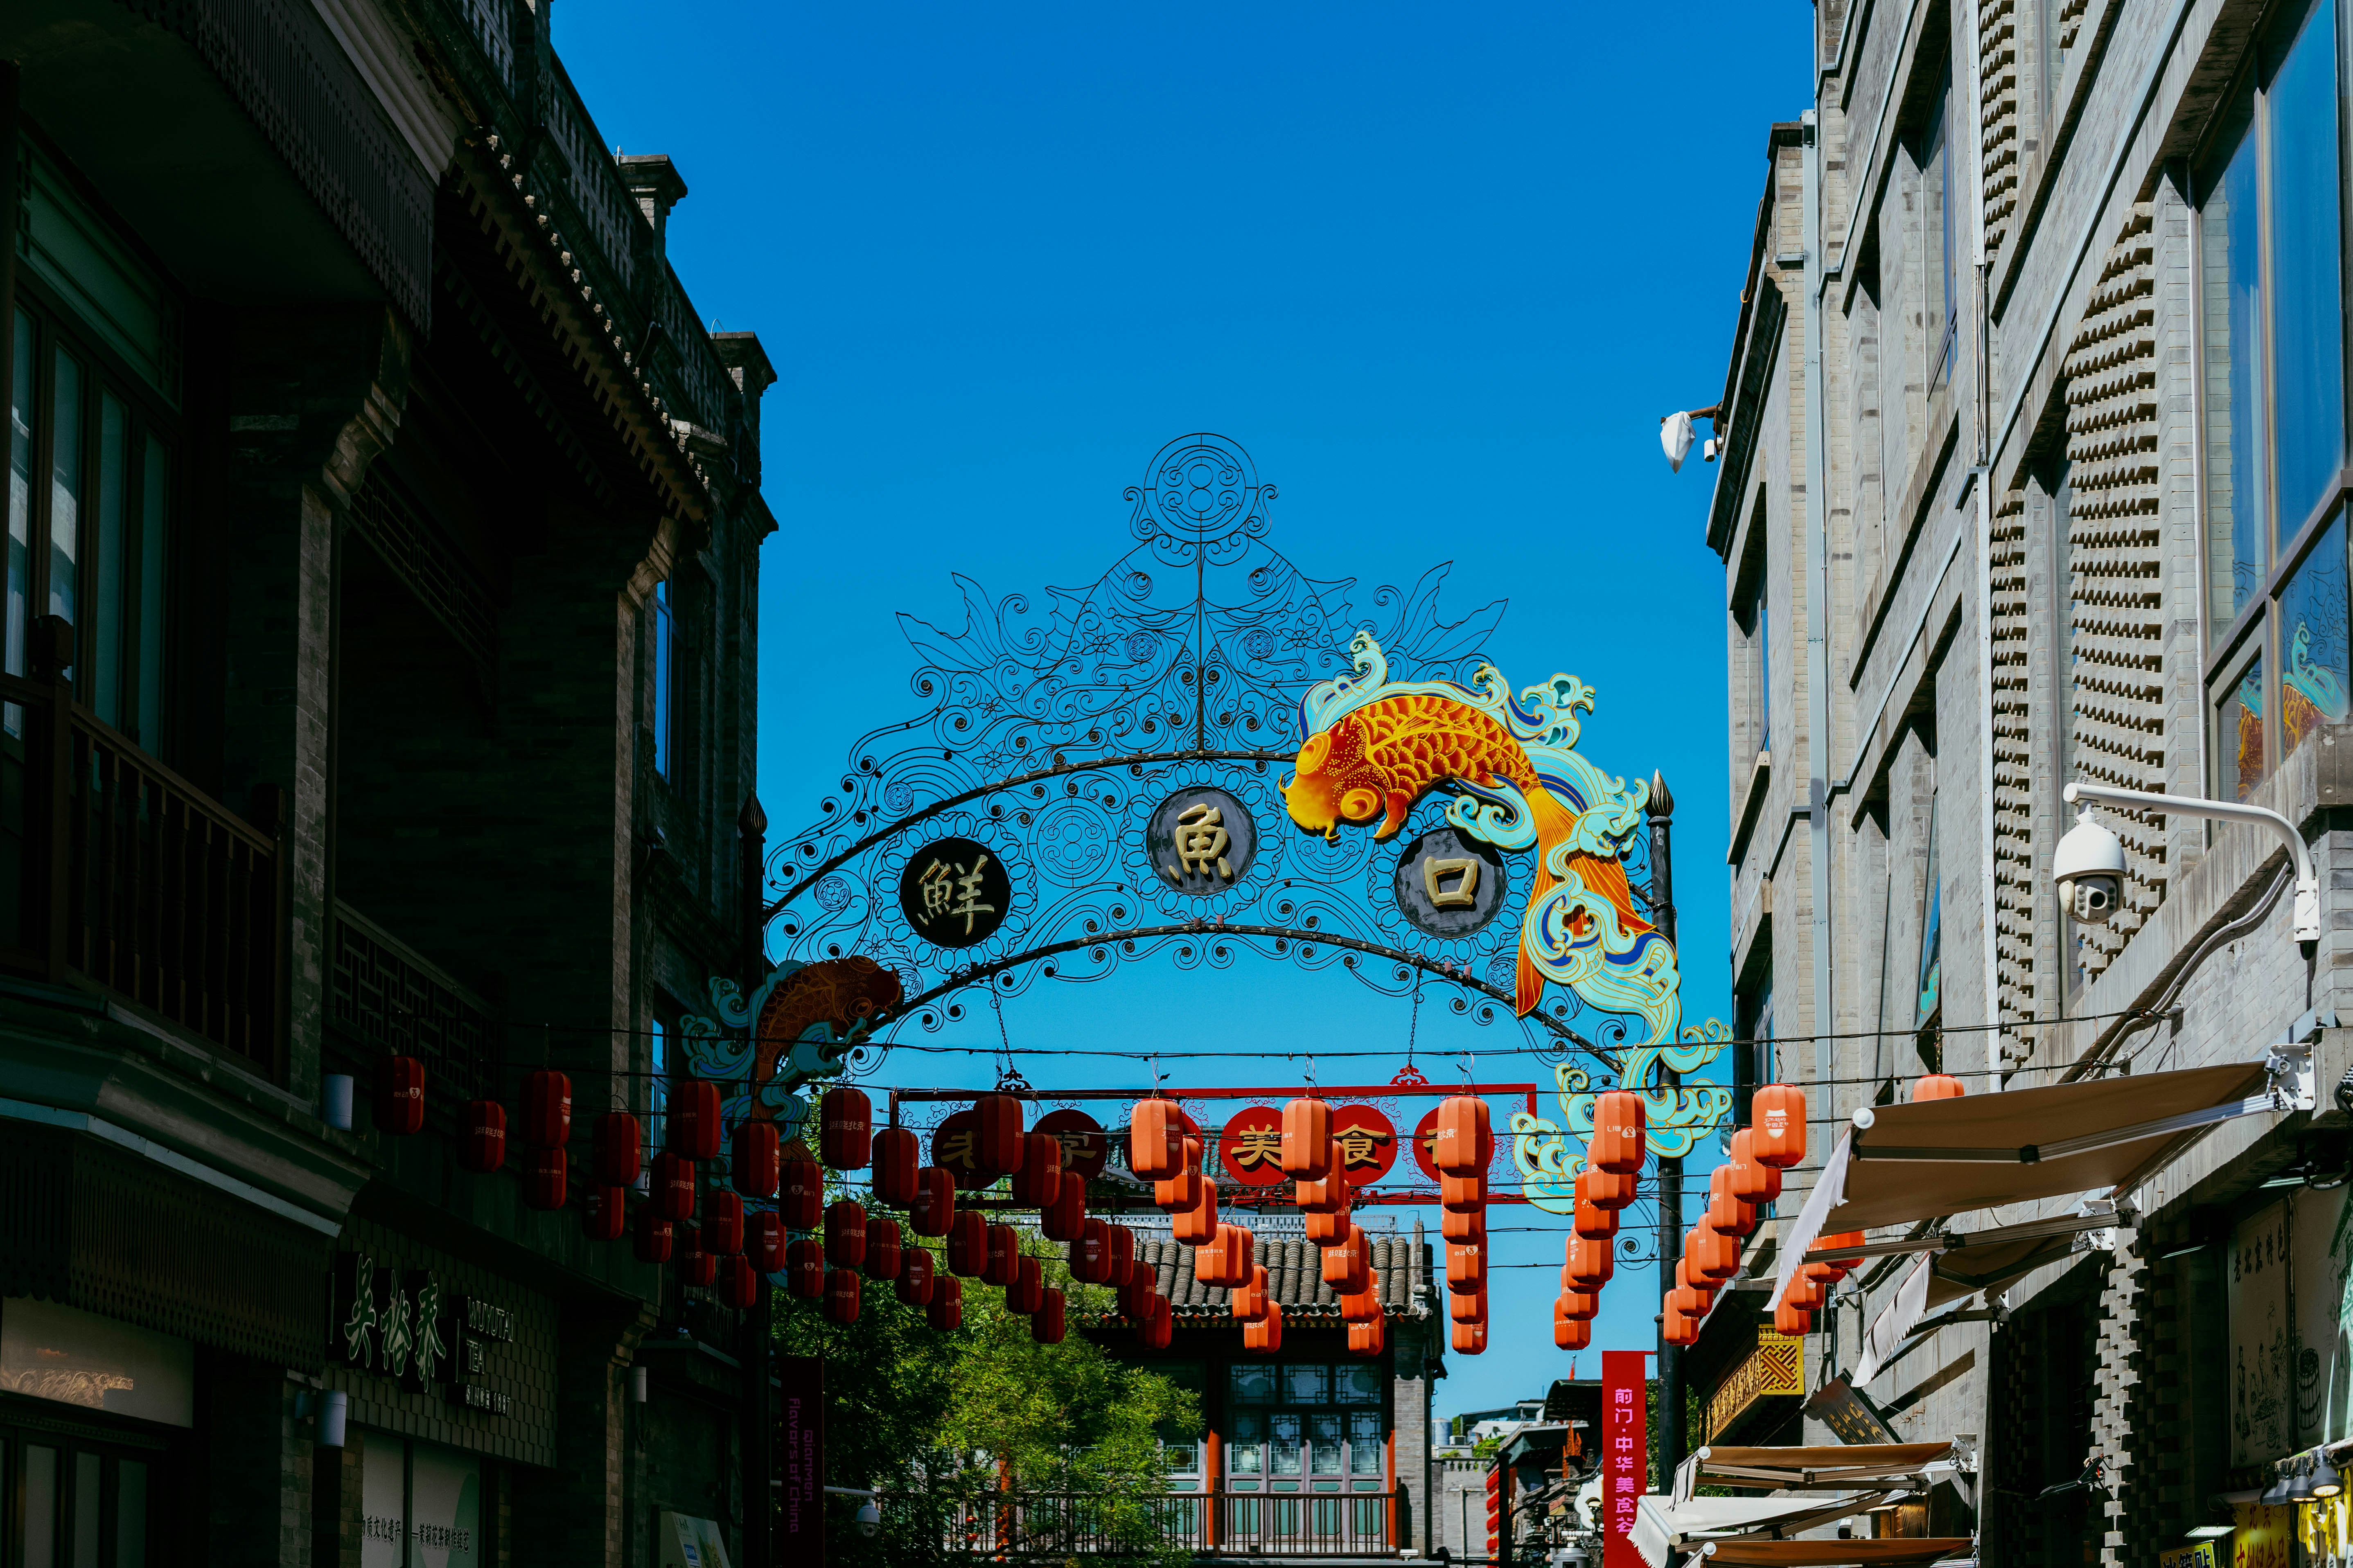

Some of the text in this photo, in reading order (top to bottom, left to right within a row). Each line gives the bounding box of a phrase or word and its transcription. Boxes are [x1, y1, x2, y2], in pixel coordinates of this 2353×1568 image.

[468, 1296, 514, 1343] WUYUTAI
[467, 1338, 485, 1375] TEA
[466, 1384, 511, 1417] SINCE 1887
[789, 1397, 801, 1533] Flavors of China
[802, 1429, 815, 1501] Qianmen
